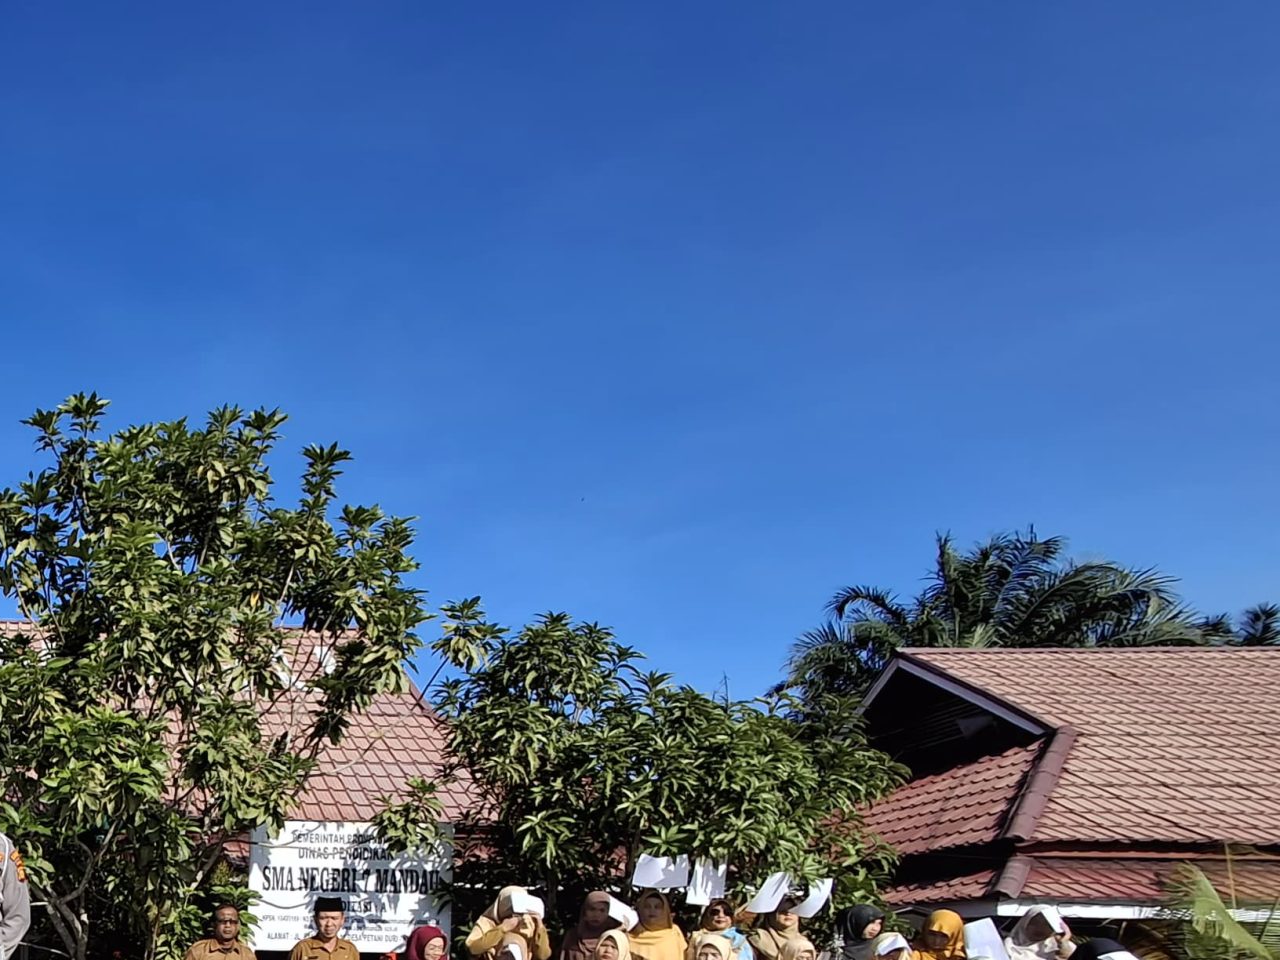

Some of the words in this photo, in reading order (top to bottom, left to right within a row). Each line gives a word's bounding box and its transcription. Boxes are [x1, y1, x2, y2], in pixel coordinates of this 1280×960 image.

[293, 833, 344, 844] PEMERINTAH
[298, 847, 329, 860] DINAS
[262, 865, 294, 891] SMA
[298, 866, 356, 893] NEGERI
[362, 868, 370, 894] 7
[375, 868, 440, 894] MANDAU
